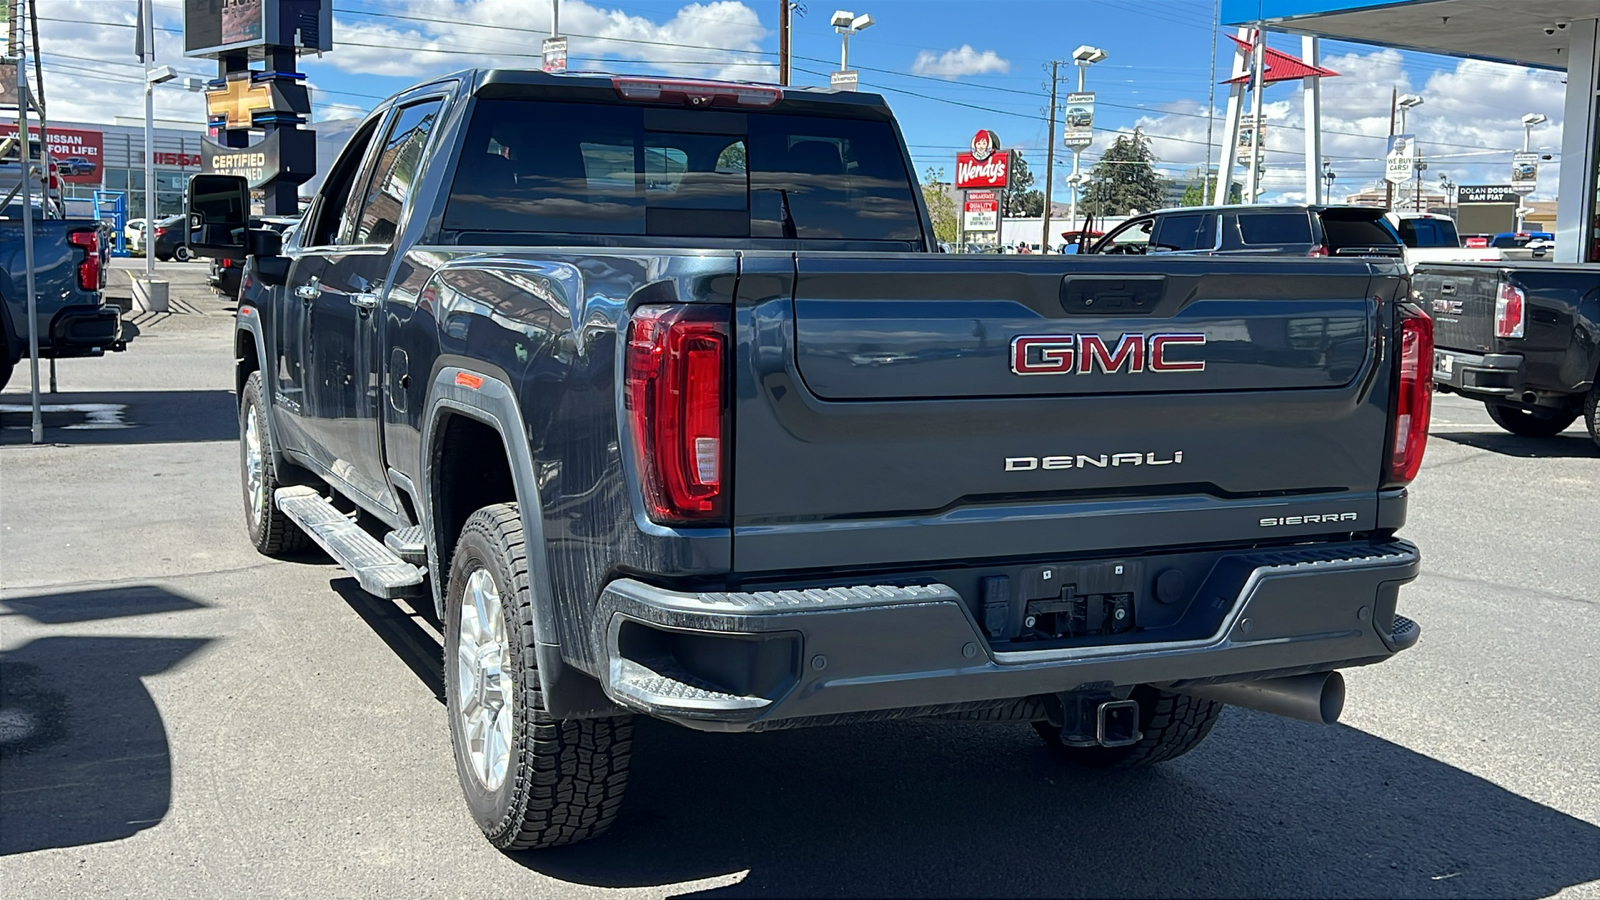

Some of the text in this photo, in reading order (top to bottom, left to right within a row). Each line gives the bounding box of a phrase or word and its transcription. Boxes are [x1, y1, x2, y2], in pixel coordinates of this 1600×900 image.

[48, 145, 97, 155] FOR LIFE!
[212, 152, 265, 169] CERTIFIED
[958, 156, 1006, 184] Wendy's
[1010, 332, 1207, 376] GMC
[1004, 450, 1183, 472] DENALI
[1259, 512, 1357, 527] SIERRA
